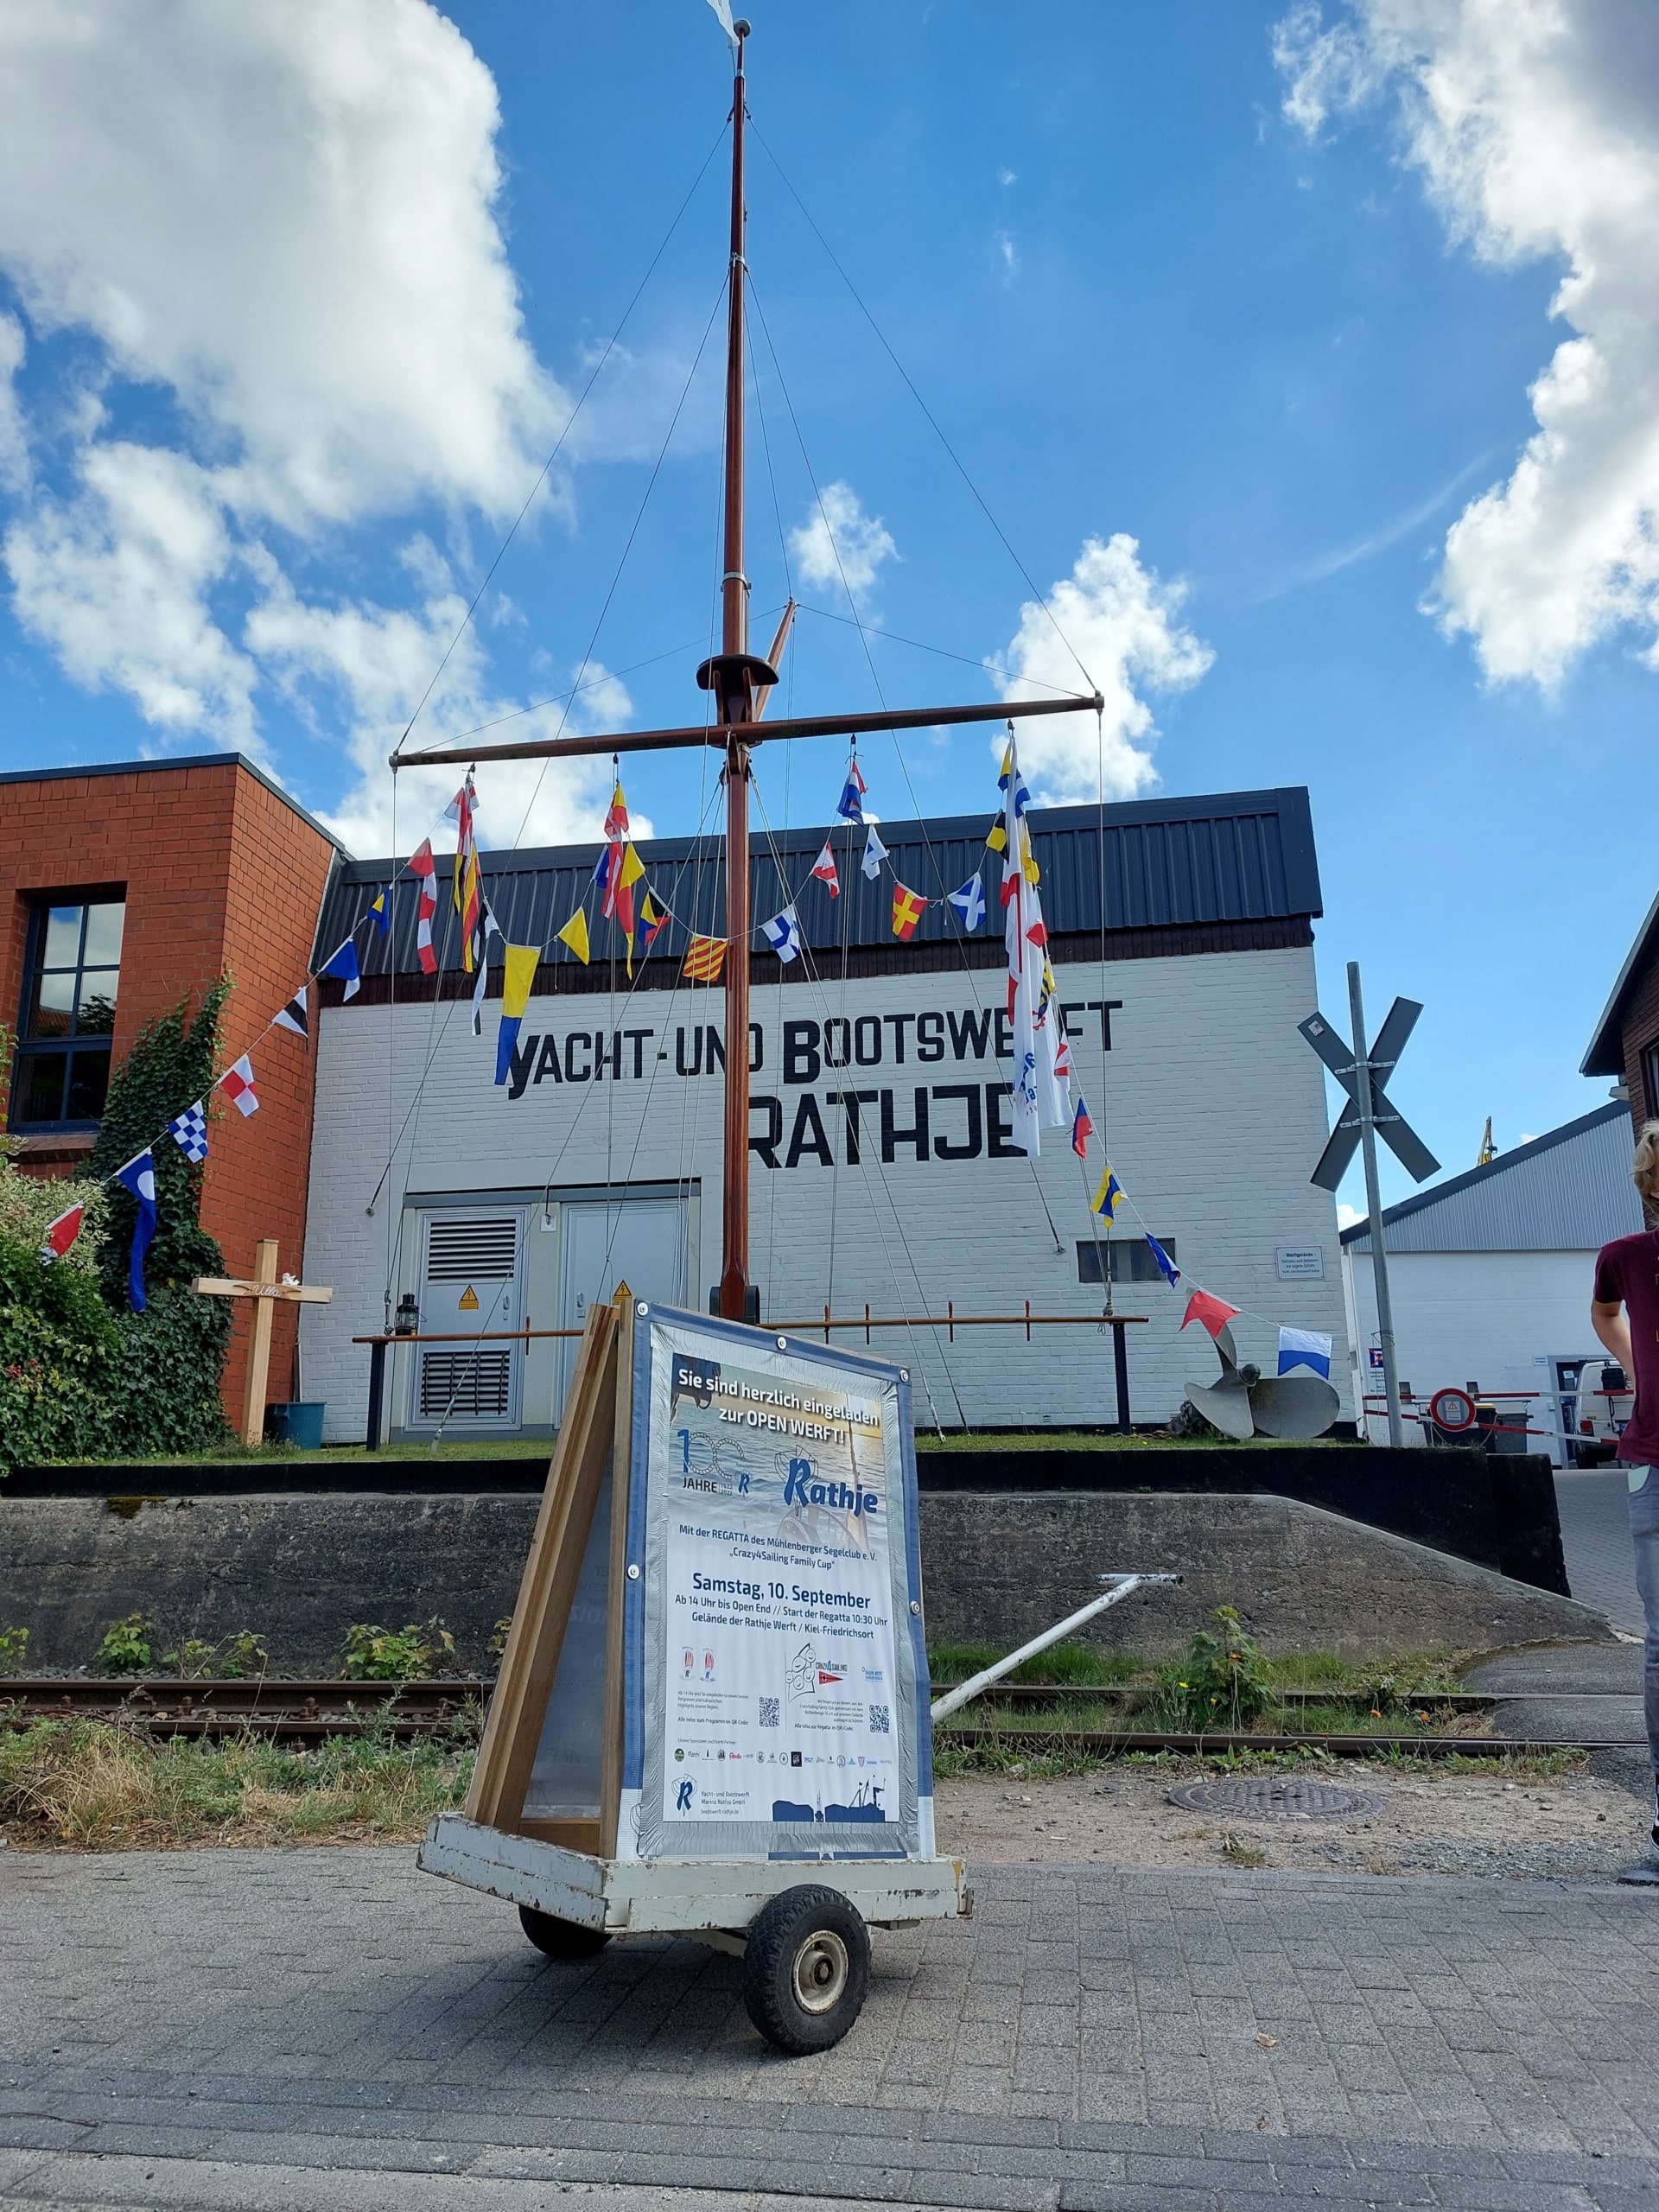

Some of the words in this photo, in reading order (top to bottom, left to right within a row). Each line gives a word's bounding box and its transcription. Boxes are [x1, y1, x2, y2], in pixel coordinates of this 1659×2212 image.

[782, 1000, 1122, 1084] BOOTSWEFT
[678, 1368, 702, 1389] Sie
[706, 1376, 738, 1396] sind
[741, 1382, 800, 1409] herzlich
[803, 1397, 879, 1427] eingeladen
[718, 1408, 744, 1423] zur
[747, 1409, 787, 1433] OPEN
[790, 1418, 845, 1444] WERFT!
[682, 1476, 718, 1493] JAHRE
[783, 1458, 879, 1517] Rathje
[679, 1524, 694, 1535] Mit
[696, 1527, 710, 1538] der
[712, 1529, 749, 1543] REGATTA
[751, 1535, 766, 1546] des
[766, 1536, 823, 1554] Mühlenberger
[823, 1545, 861, 1560] Segelclub
[790, 1555, 816, 1569] Family
[692, 1572, 765, 1601] Samstag,
[767, 1581, 789, 1600] 10.
[791, 1585, 871, 1609] September
[675, 1594, 687, 1605] Ab
[689, 1595, 699, 1606] 14
[701, 1597, 716, 1608] Uhr
[717, 1599, 731, 1610] bis
[732, 1600, 754, 1613] Open
[755, 1603, 771, 1614] End
[783, 1606, 804, 1618] Start
[804, 1609, 818, 1619] der
[819, 1610, 851, 1623] Regatta
[852, 1614, 873, 1624] 10:30
[874, 1616, 888, 1626] Uhr
[692, 1611, 728, 1624] Gelände
[728, 1615, 744, 1626] der
[745, 1617, 772, 1630] Rathje
[772, 1619, 797, 1631] Werft
[804, 1624, 874, 1639] Kiel-Friedrichsort
